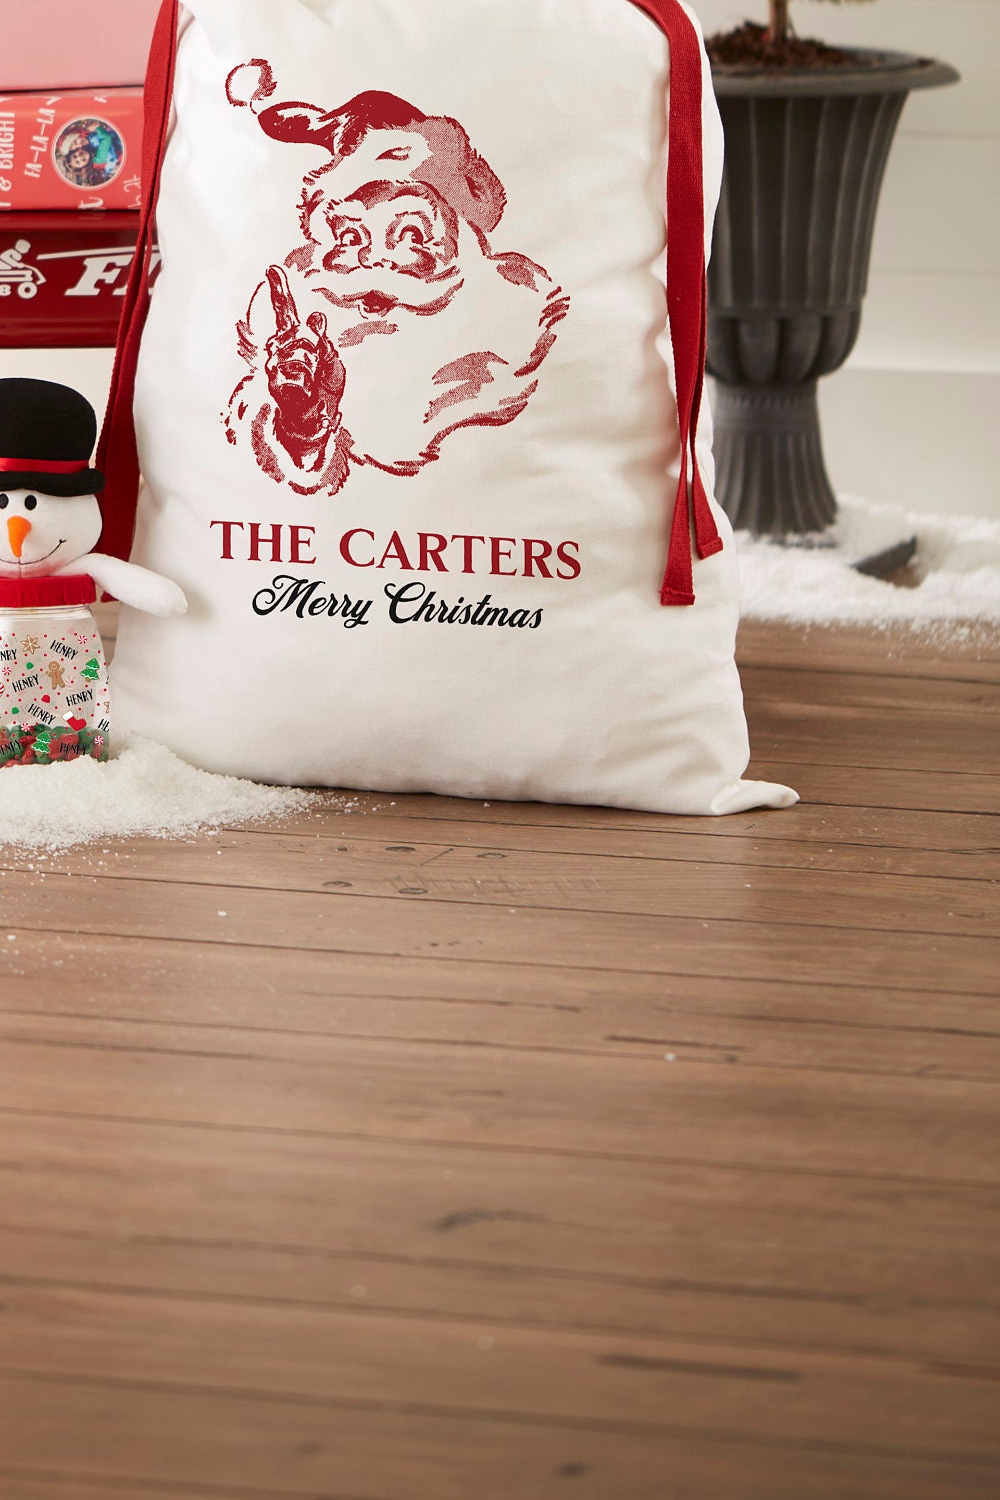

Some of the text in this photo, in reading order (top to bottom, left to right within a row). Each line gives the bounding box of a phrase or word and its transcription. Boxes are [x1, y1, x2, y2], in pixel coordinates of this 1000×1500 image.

[209, 519, 582, 580] THE CARTERS
[251, 574, 545, 629] Merry Christmas
[50, 639, 79, 660] HENRY
[12, 673, 39, 693] HENRY
[65, 688, 93, 707] HENRY
[27, 703, 56, 725] HENRY
